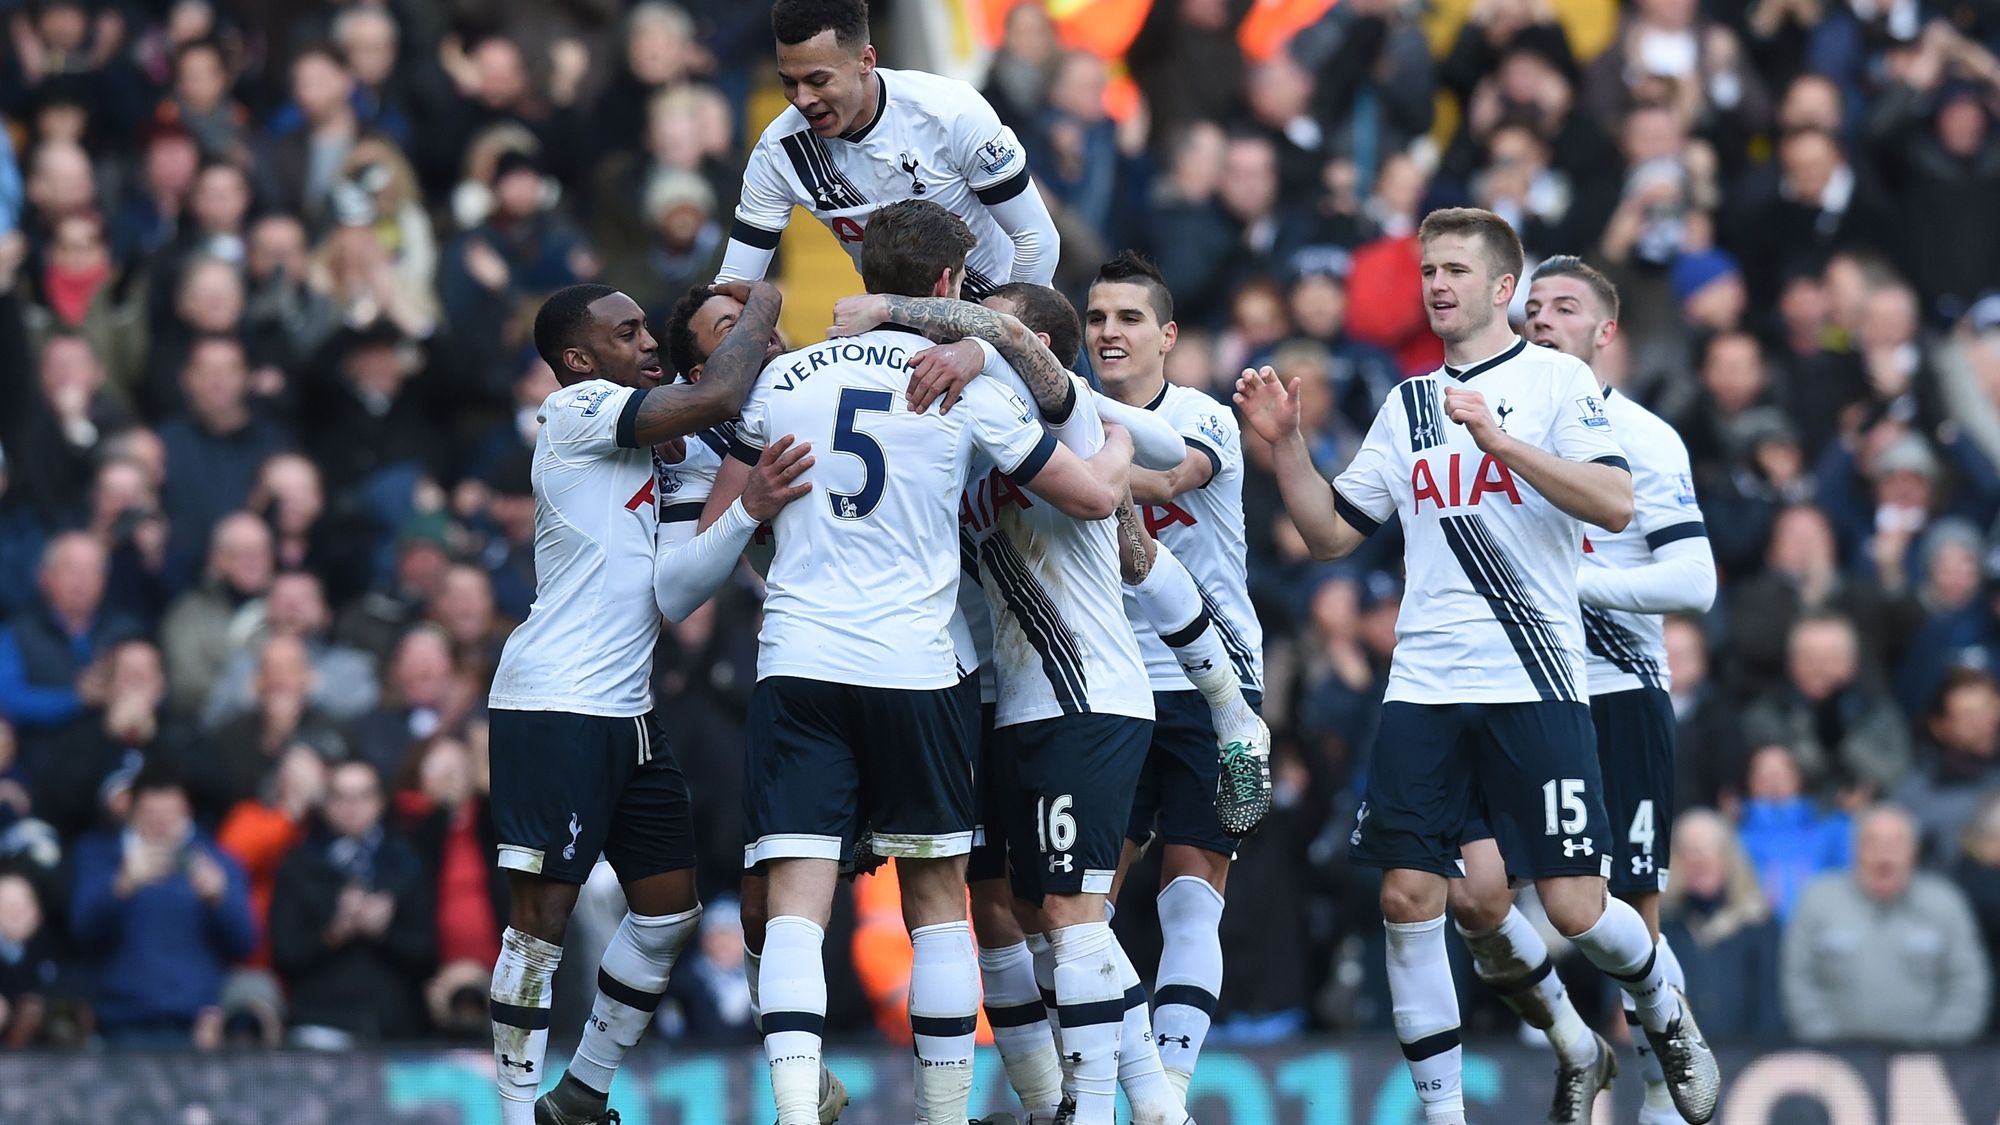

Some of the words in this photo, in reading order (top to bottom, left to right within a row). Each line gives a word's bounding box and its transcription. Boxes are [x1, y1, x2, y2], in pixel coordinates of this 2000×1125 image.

[826, 386, 896, 520] 5
[1411, 452, 1523, 515] AIA
[1037, 794, 1077, 852] 16
[1542, 778, 1588, 835] 15
[1628, 799, 1655, 855] 4
